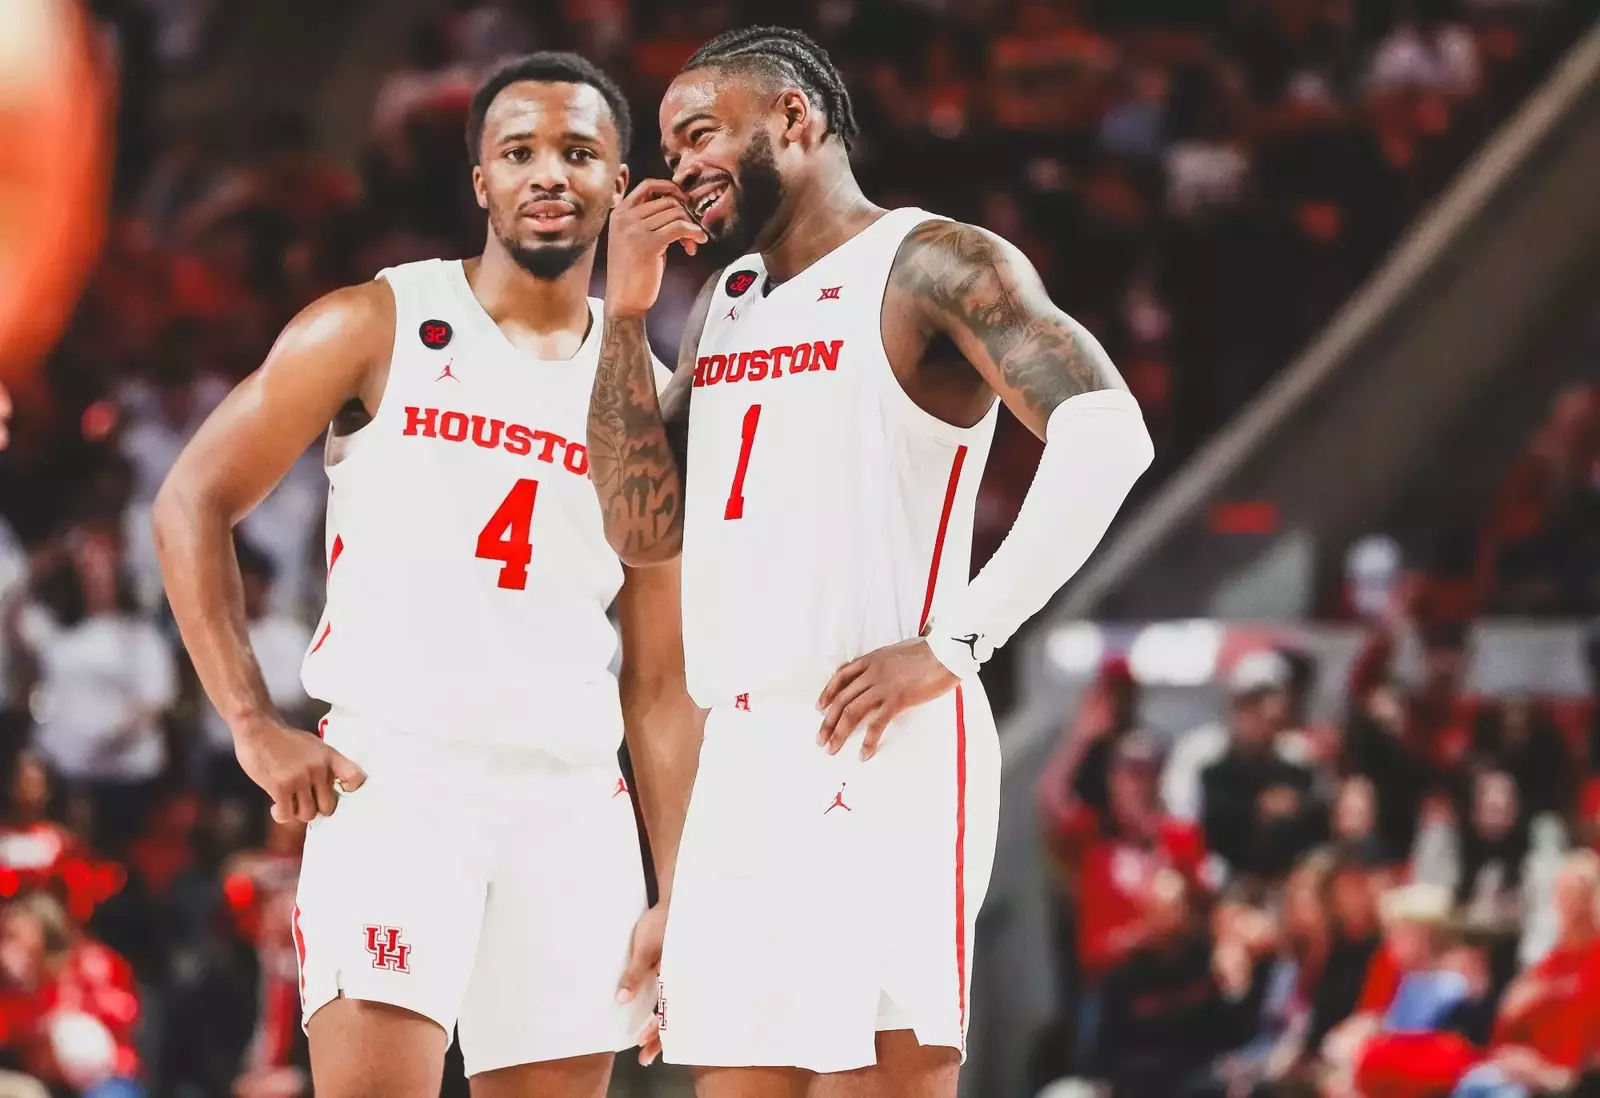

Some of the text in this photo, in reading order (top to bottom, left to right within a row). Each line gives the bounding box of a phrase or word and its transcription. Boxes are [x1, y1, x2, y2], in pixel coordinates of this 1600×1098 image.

[729, 274, 755, 293] 32
[424, 324, 448, 344] 32
[692, 340, 844, 388] HOUSTON
[402, 406, 591, 480] HOUSTO
[723, 404, 762, 521] 1
[475, 478, 539, 591] 4
[363, 924, 412, 974] UH
